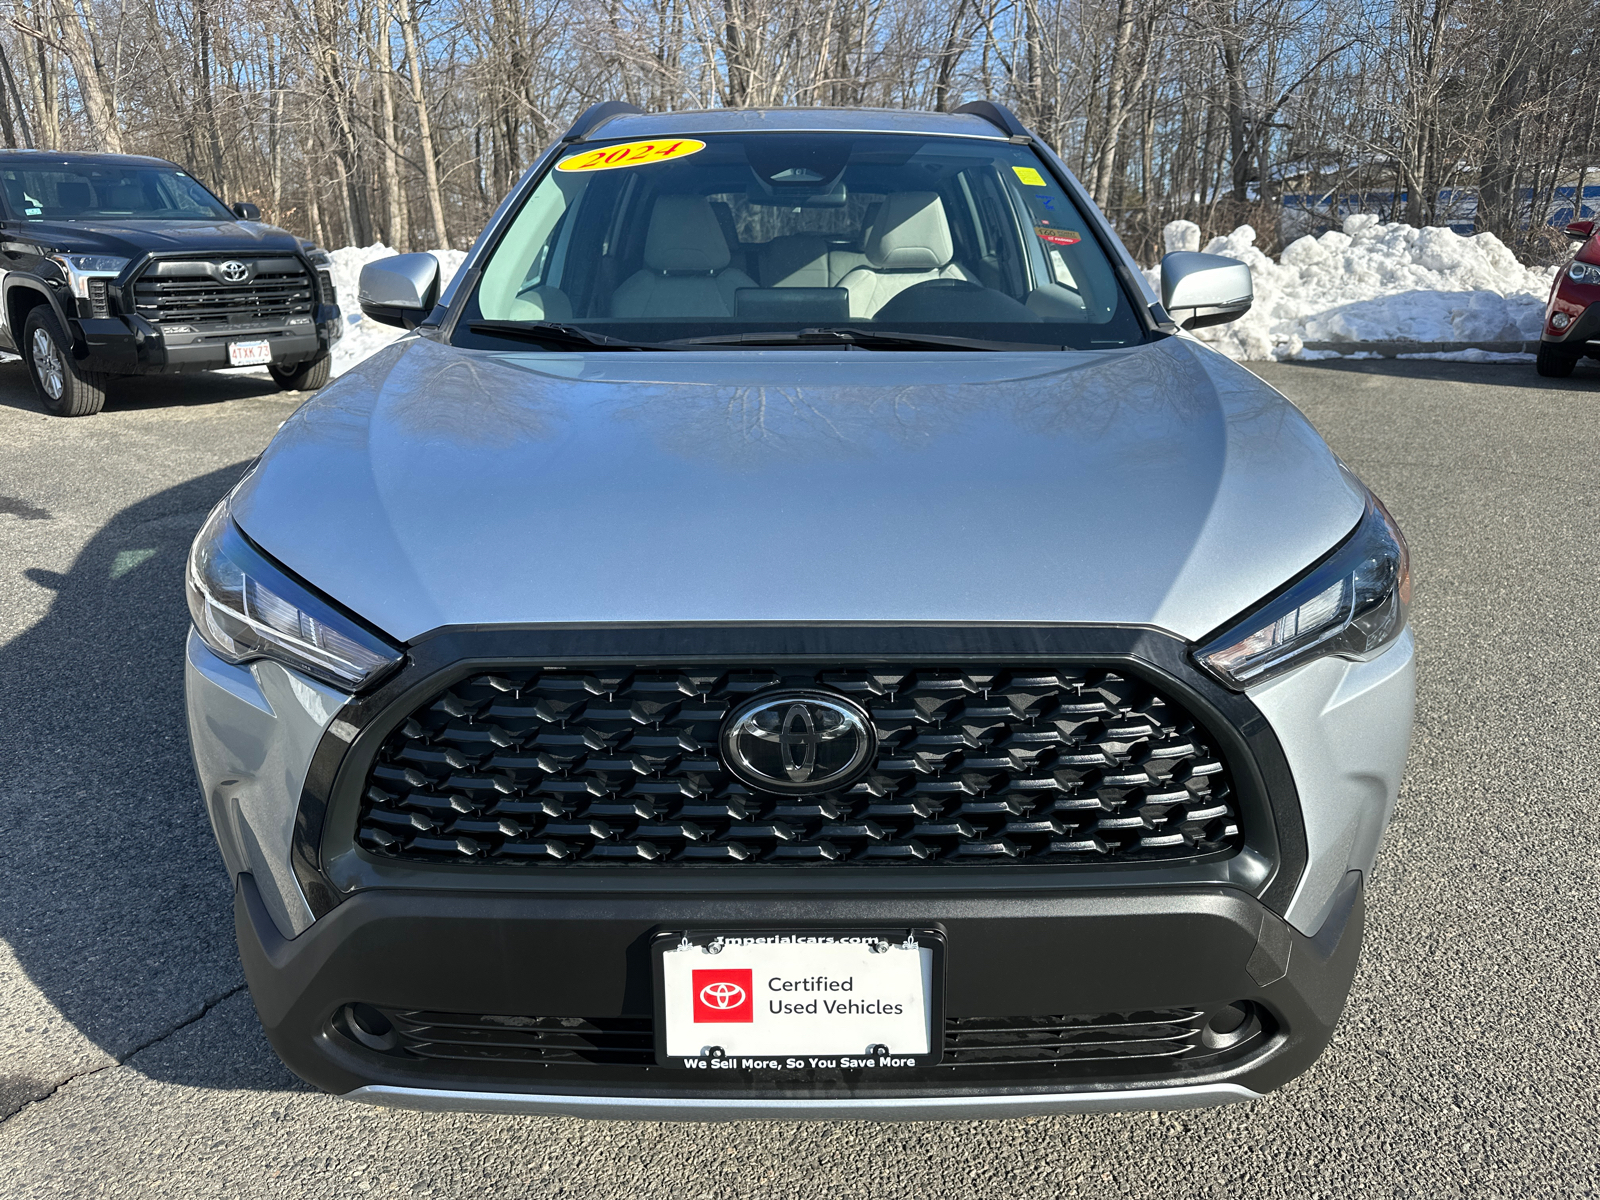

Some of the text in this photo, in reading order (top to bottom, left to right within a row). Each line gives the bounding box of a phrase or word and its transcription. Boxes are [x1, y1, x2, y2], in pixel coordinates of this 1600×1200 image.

[578, 141, 684, 169] 2024
[232, 345, 270, 359] 4TXK 73
[716, 934, 879, 946] Imperialcars.com
[768, 976, 854, 992] Certified
[769, 999, 903, 1015] Used Vehicles
[683, 1056, 916, 1071] We Sell More, So You Save More
